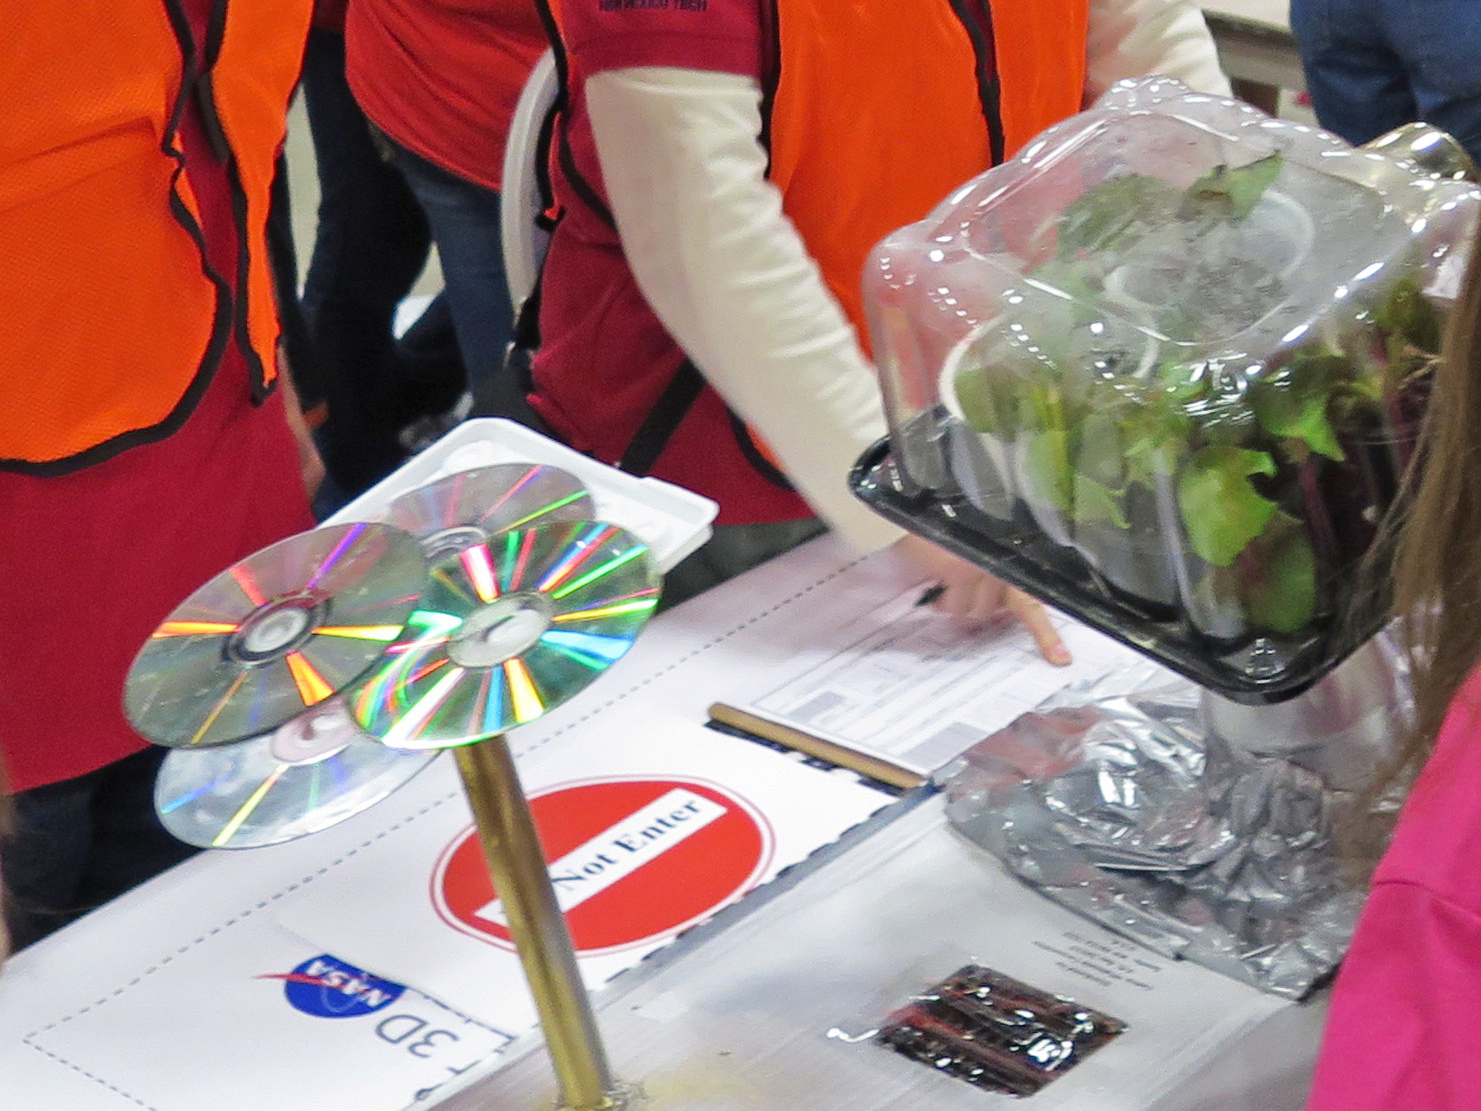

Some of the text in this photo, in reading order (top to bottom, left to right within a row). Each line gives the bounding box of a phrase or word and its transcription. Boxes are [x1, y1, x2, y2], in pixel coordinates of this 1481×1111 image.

[550, 798, 702, 892] Not Enter
[304, 959, 392, 1009] NASA
[374, 1013, 460, 1059] 3D
